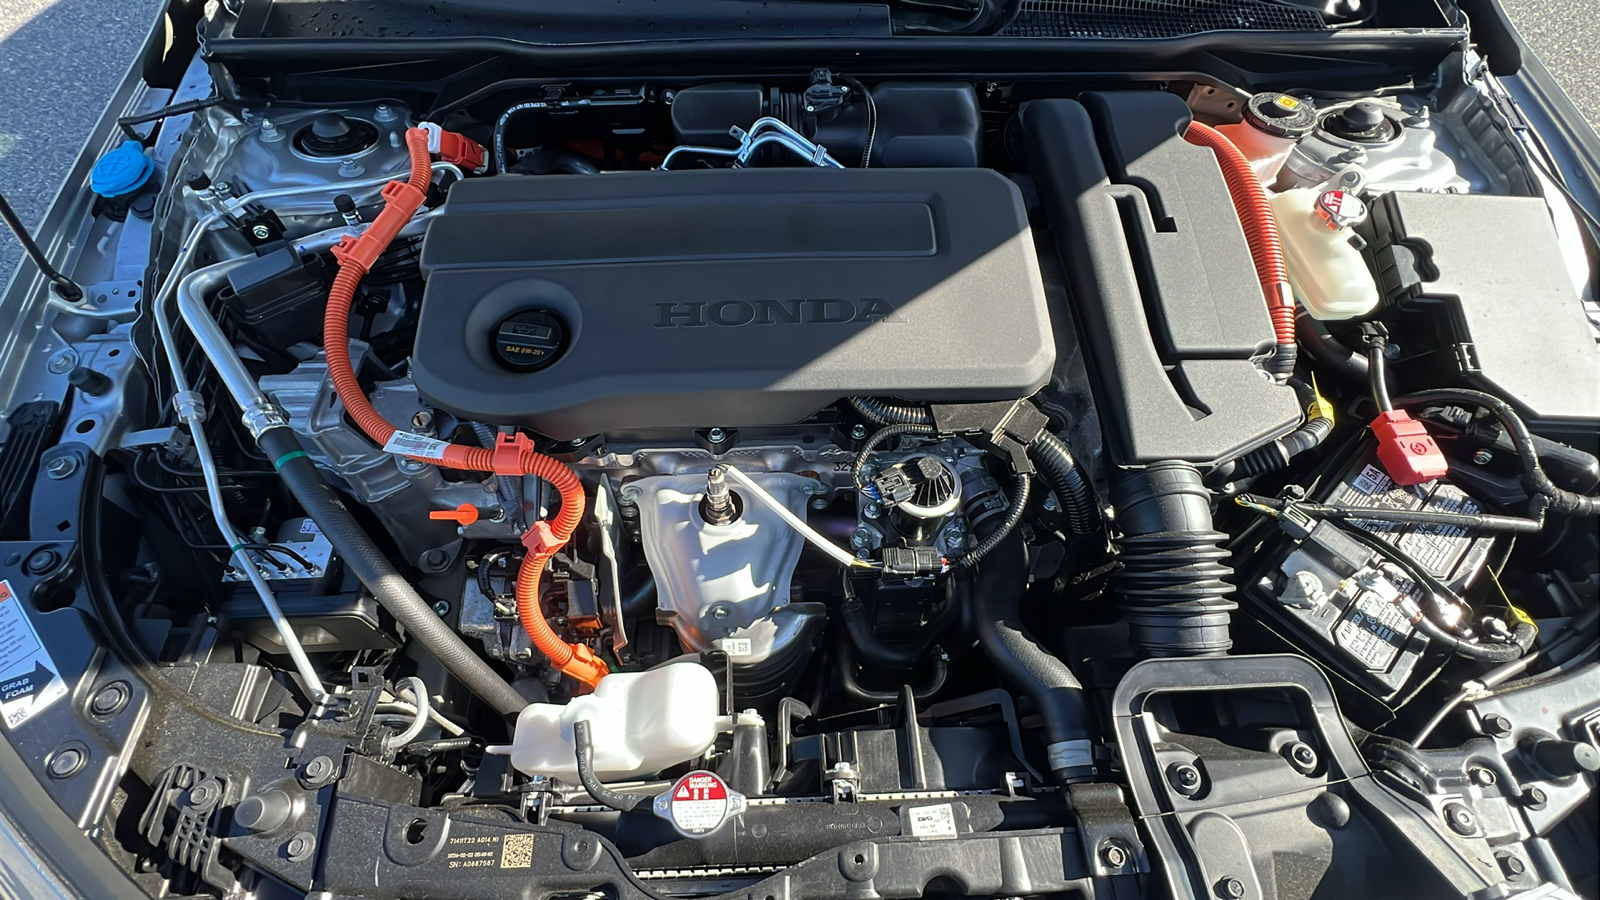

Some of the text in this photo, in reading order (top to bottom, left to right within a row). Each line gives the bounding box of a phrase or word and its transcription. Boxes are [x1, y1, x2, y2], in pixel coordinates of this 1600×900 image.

[654, 298, 909, 327] HONDA
[505, 345, 521, 353] SAE
[1366, 468, 1381, 480] 5A
[301, 523, 312, 532] 6J
[1, 678, 29, 692] GRAB
[5, 684, 34, 700] FOAM
